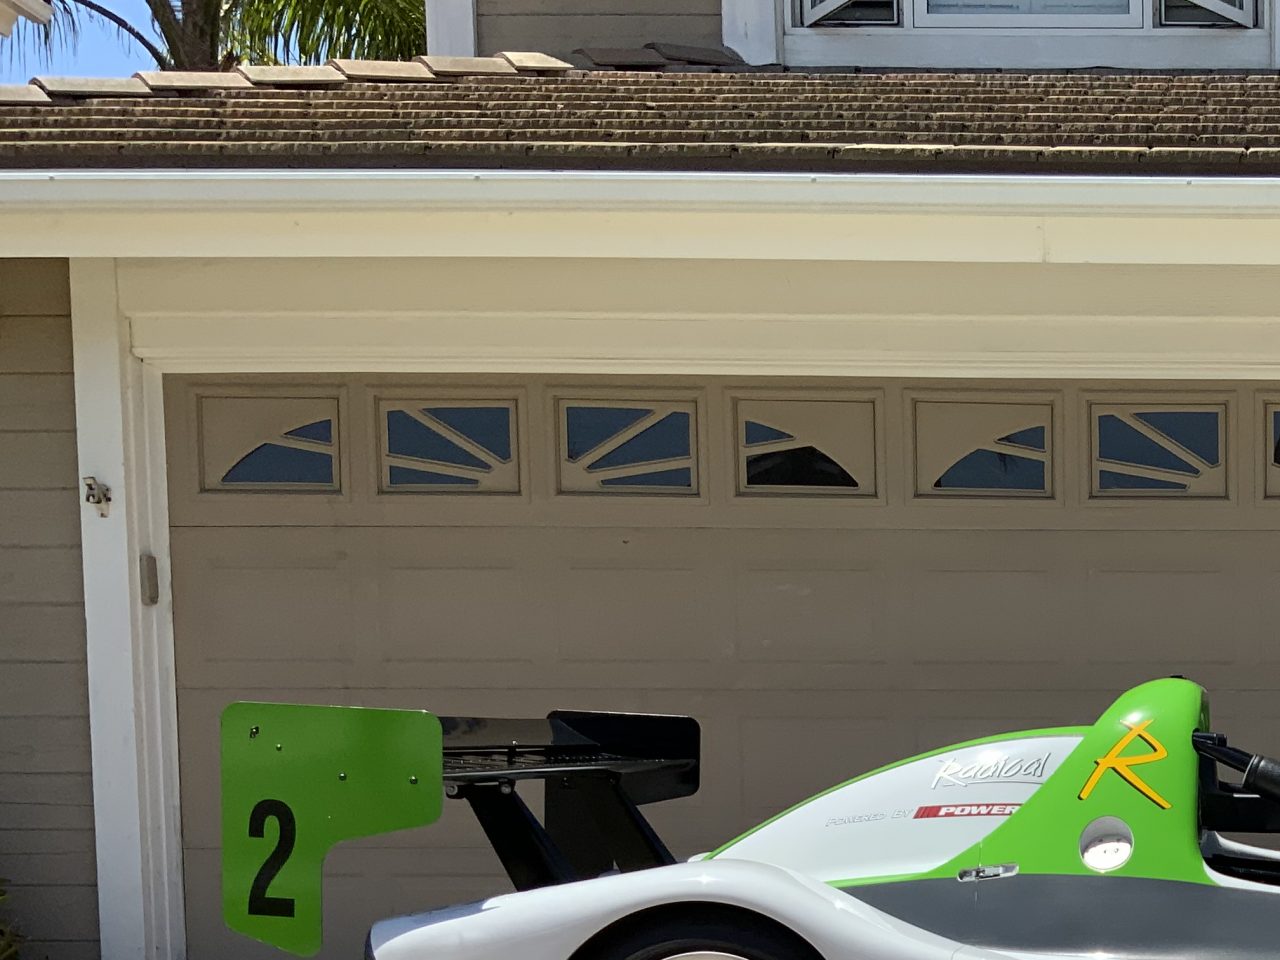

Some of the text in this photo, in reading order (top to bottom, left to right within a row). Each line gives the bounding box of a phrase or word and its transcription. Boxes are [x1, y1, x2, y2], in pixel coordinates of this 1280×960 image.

[930, 752, 1052, 790] Radical
[1078, 719, 1173, 809] R
[248, 799, 296, 918] 2
